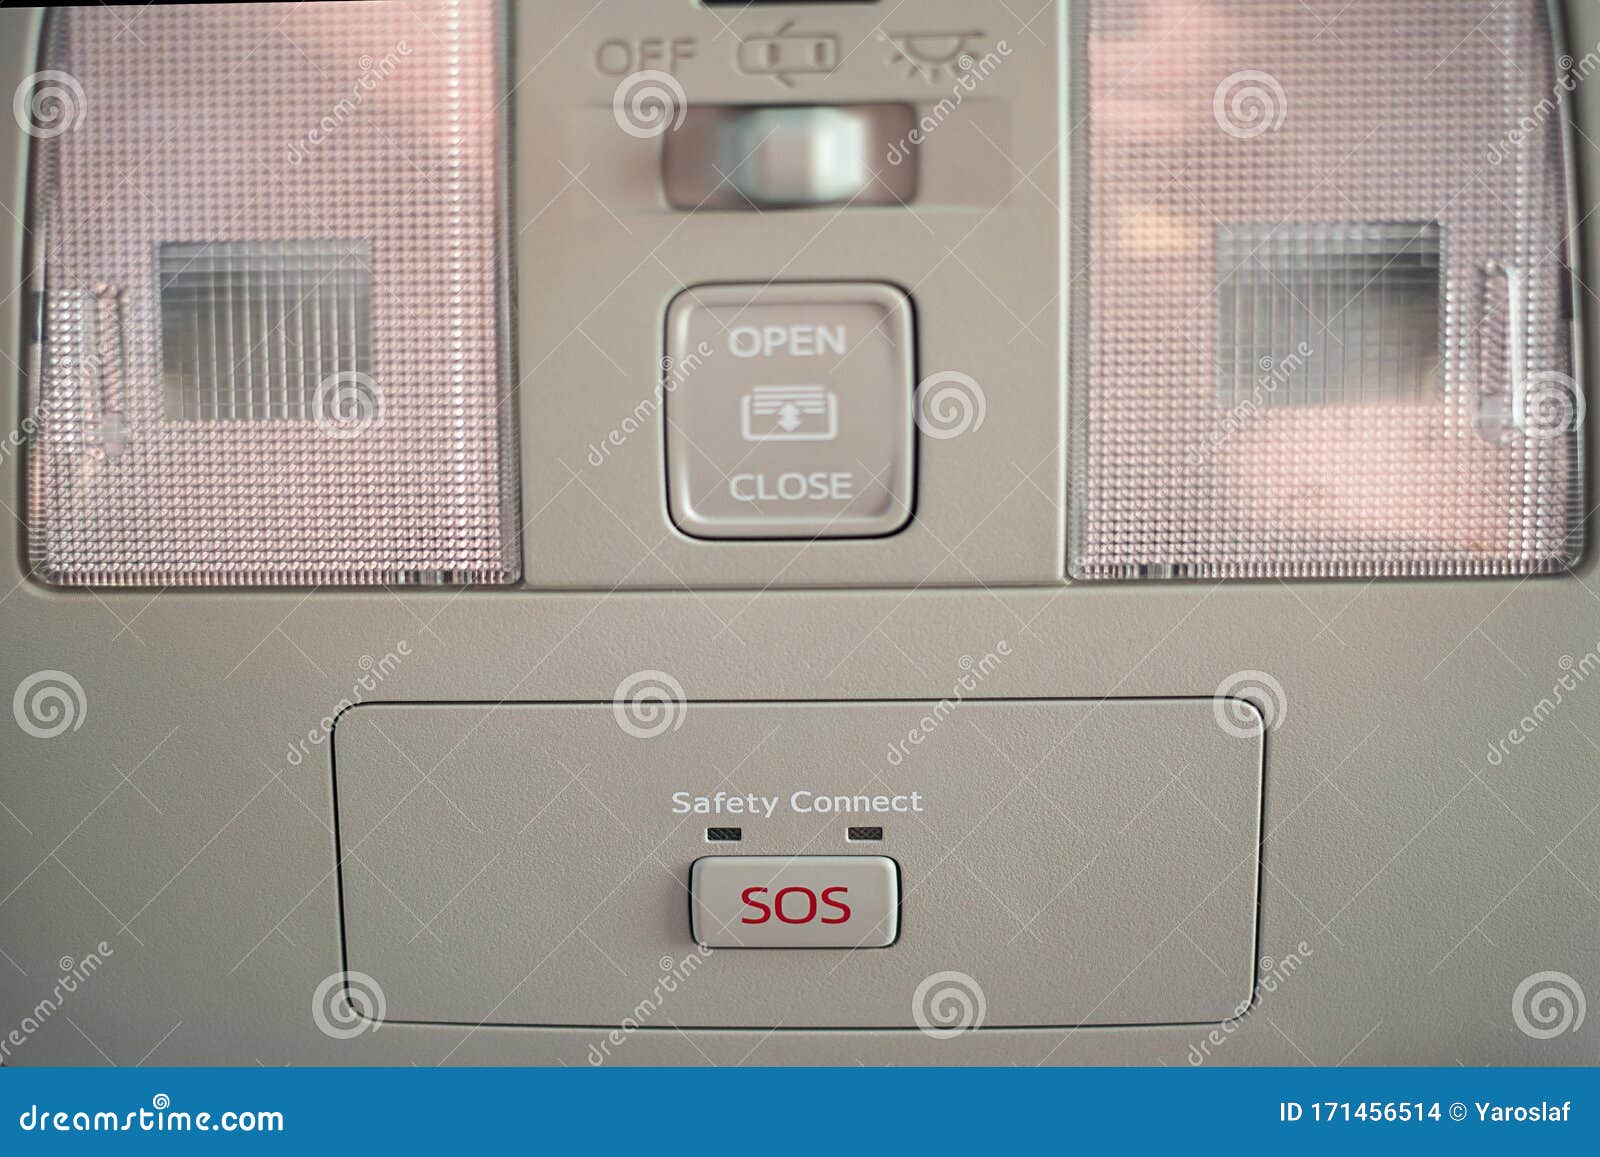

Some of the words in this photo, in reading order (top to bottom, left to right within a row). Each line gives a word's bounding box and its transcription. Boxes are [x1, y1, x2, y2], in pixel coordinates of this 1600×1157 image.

[595, 37, 698, 78] OFF
[728, 325, 847, 358] OPEN
[729, 472, 853, 501] CLOSE
[671, 791, 779, 818] Safety
[790, 791, 924, 813] Connect
[741, 886, 851, 924] SOS
